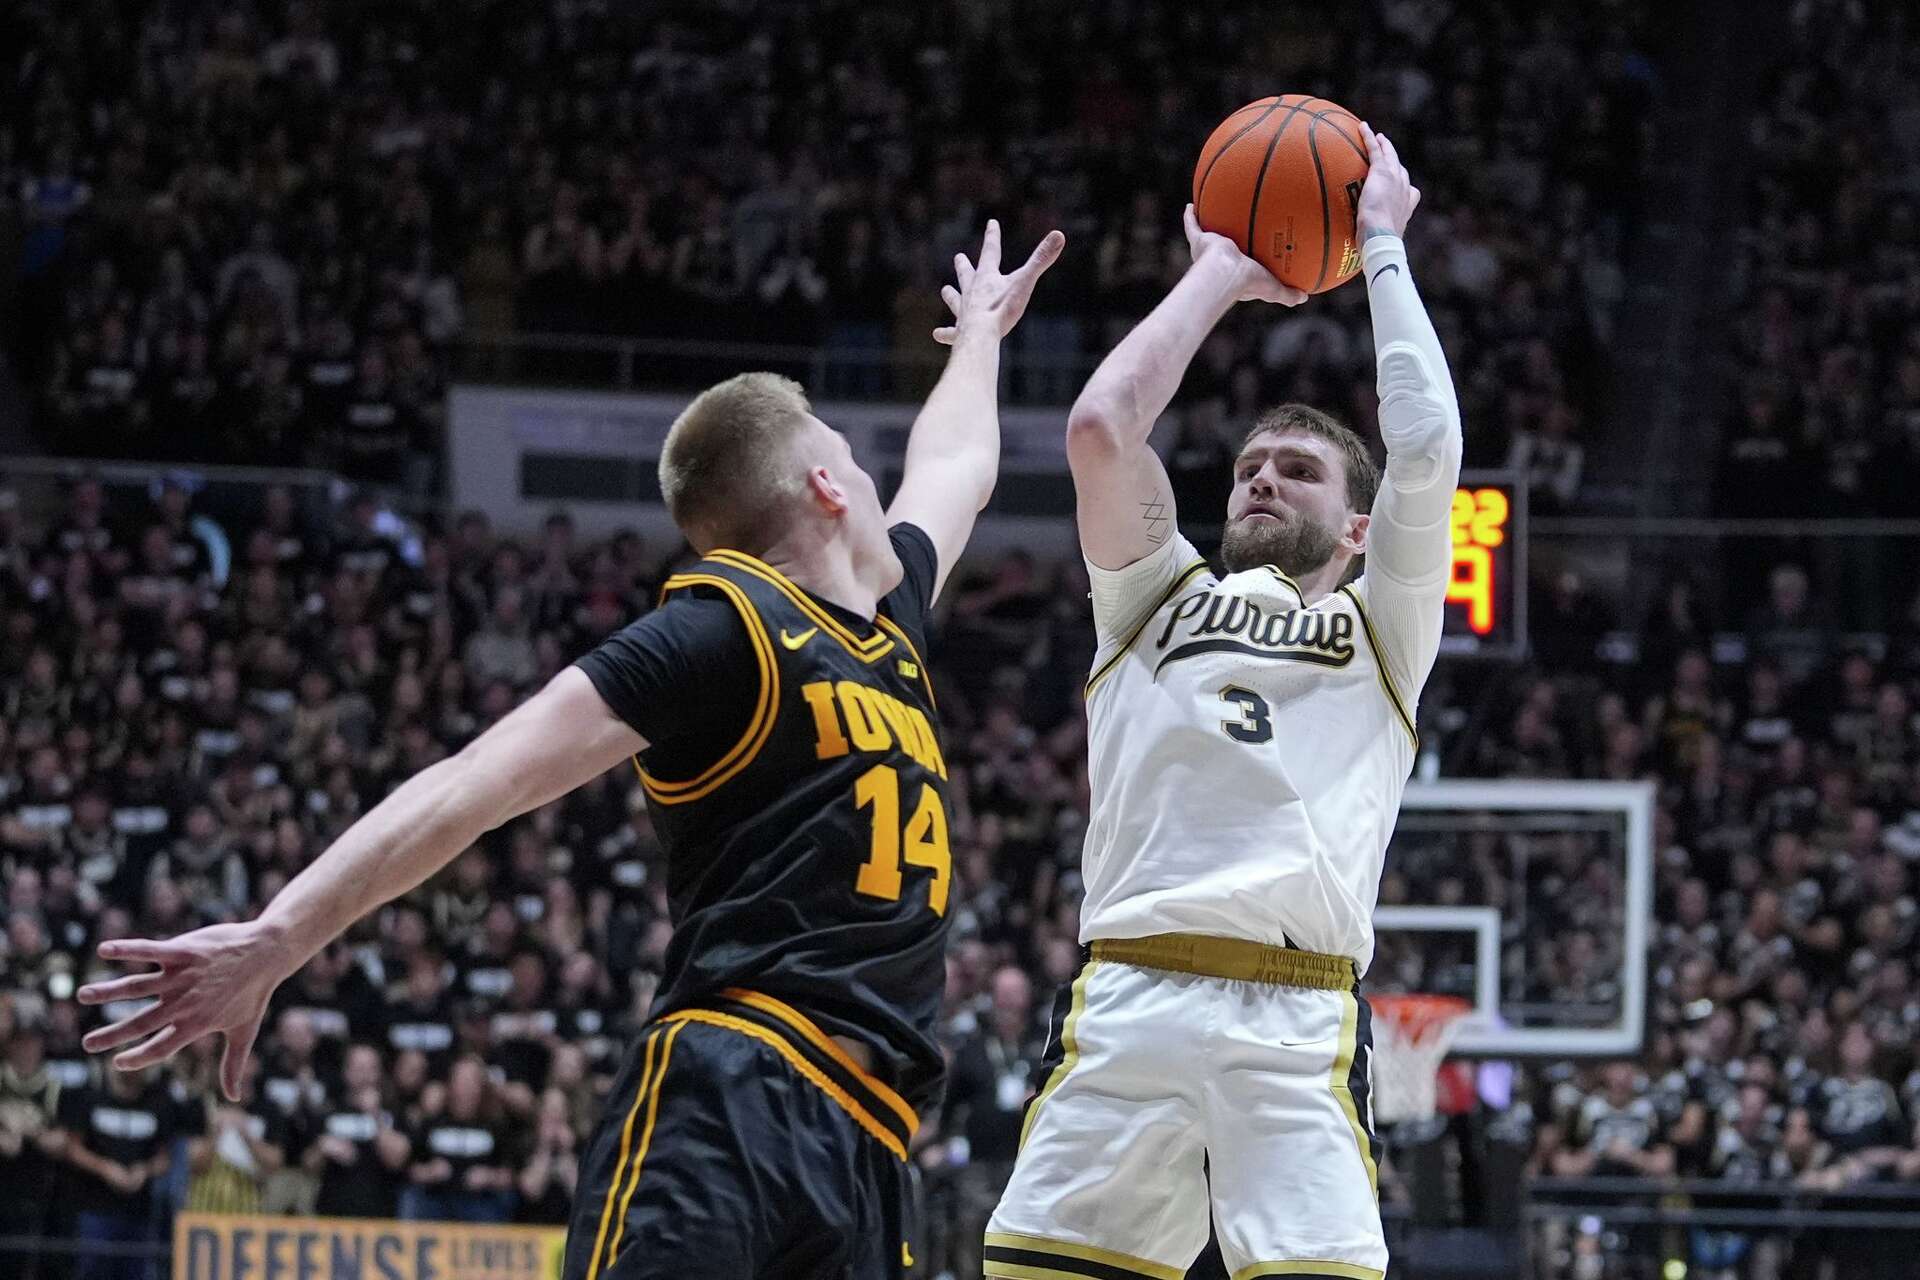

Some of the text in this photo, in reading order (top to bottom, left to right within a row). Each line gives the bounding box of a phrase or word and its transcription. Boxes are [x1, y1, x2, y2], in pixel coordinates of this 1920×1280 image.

[1155, 590, 1356, 660] Purdue
[801, 680, 949, 783] IOWA
[1219, 683, 1274, 746] 3
[854, 763, 952, 919] 14
[187, 1226, 442, 1280] DEFENSE
